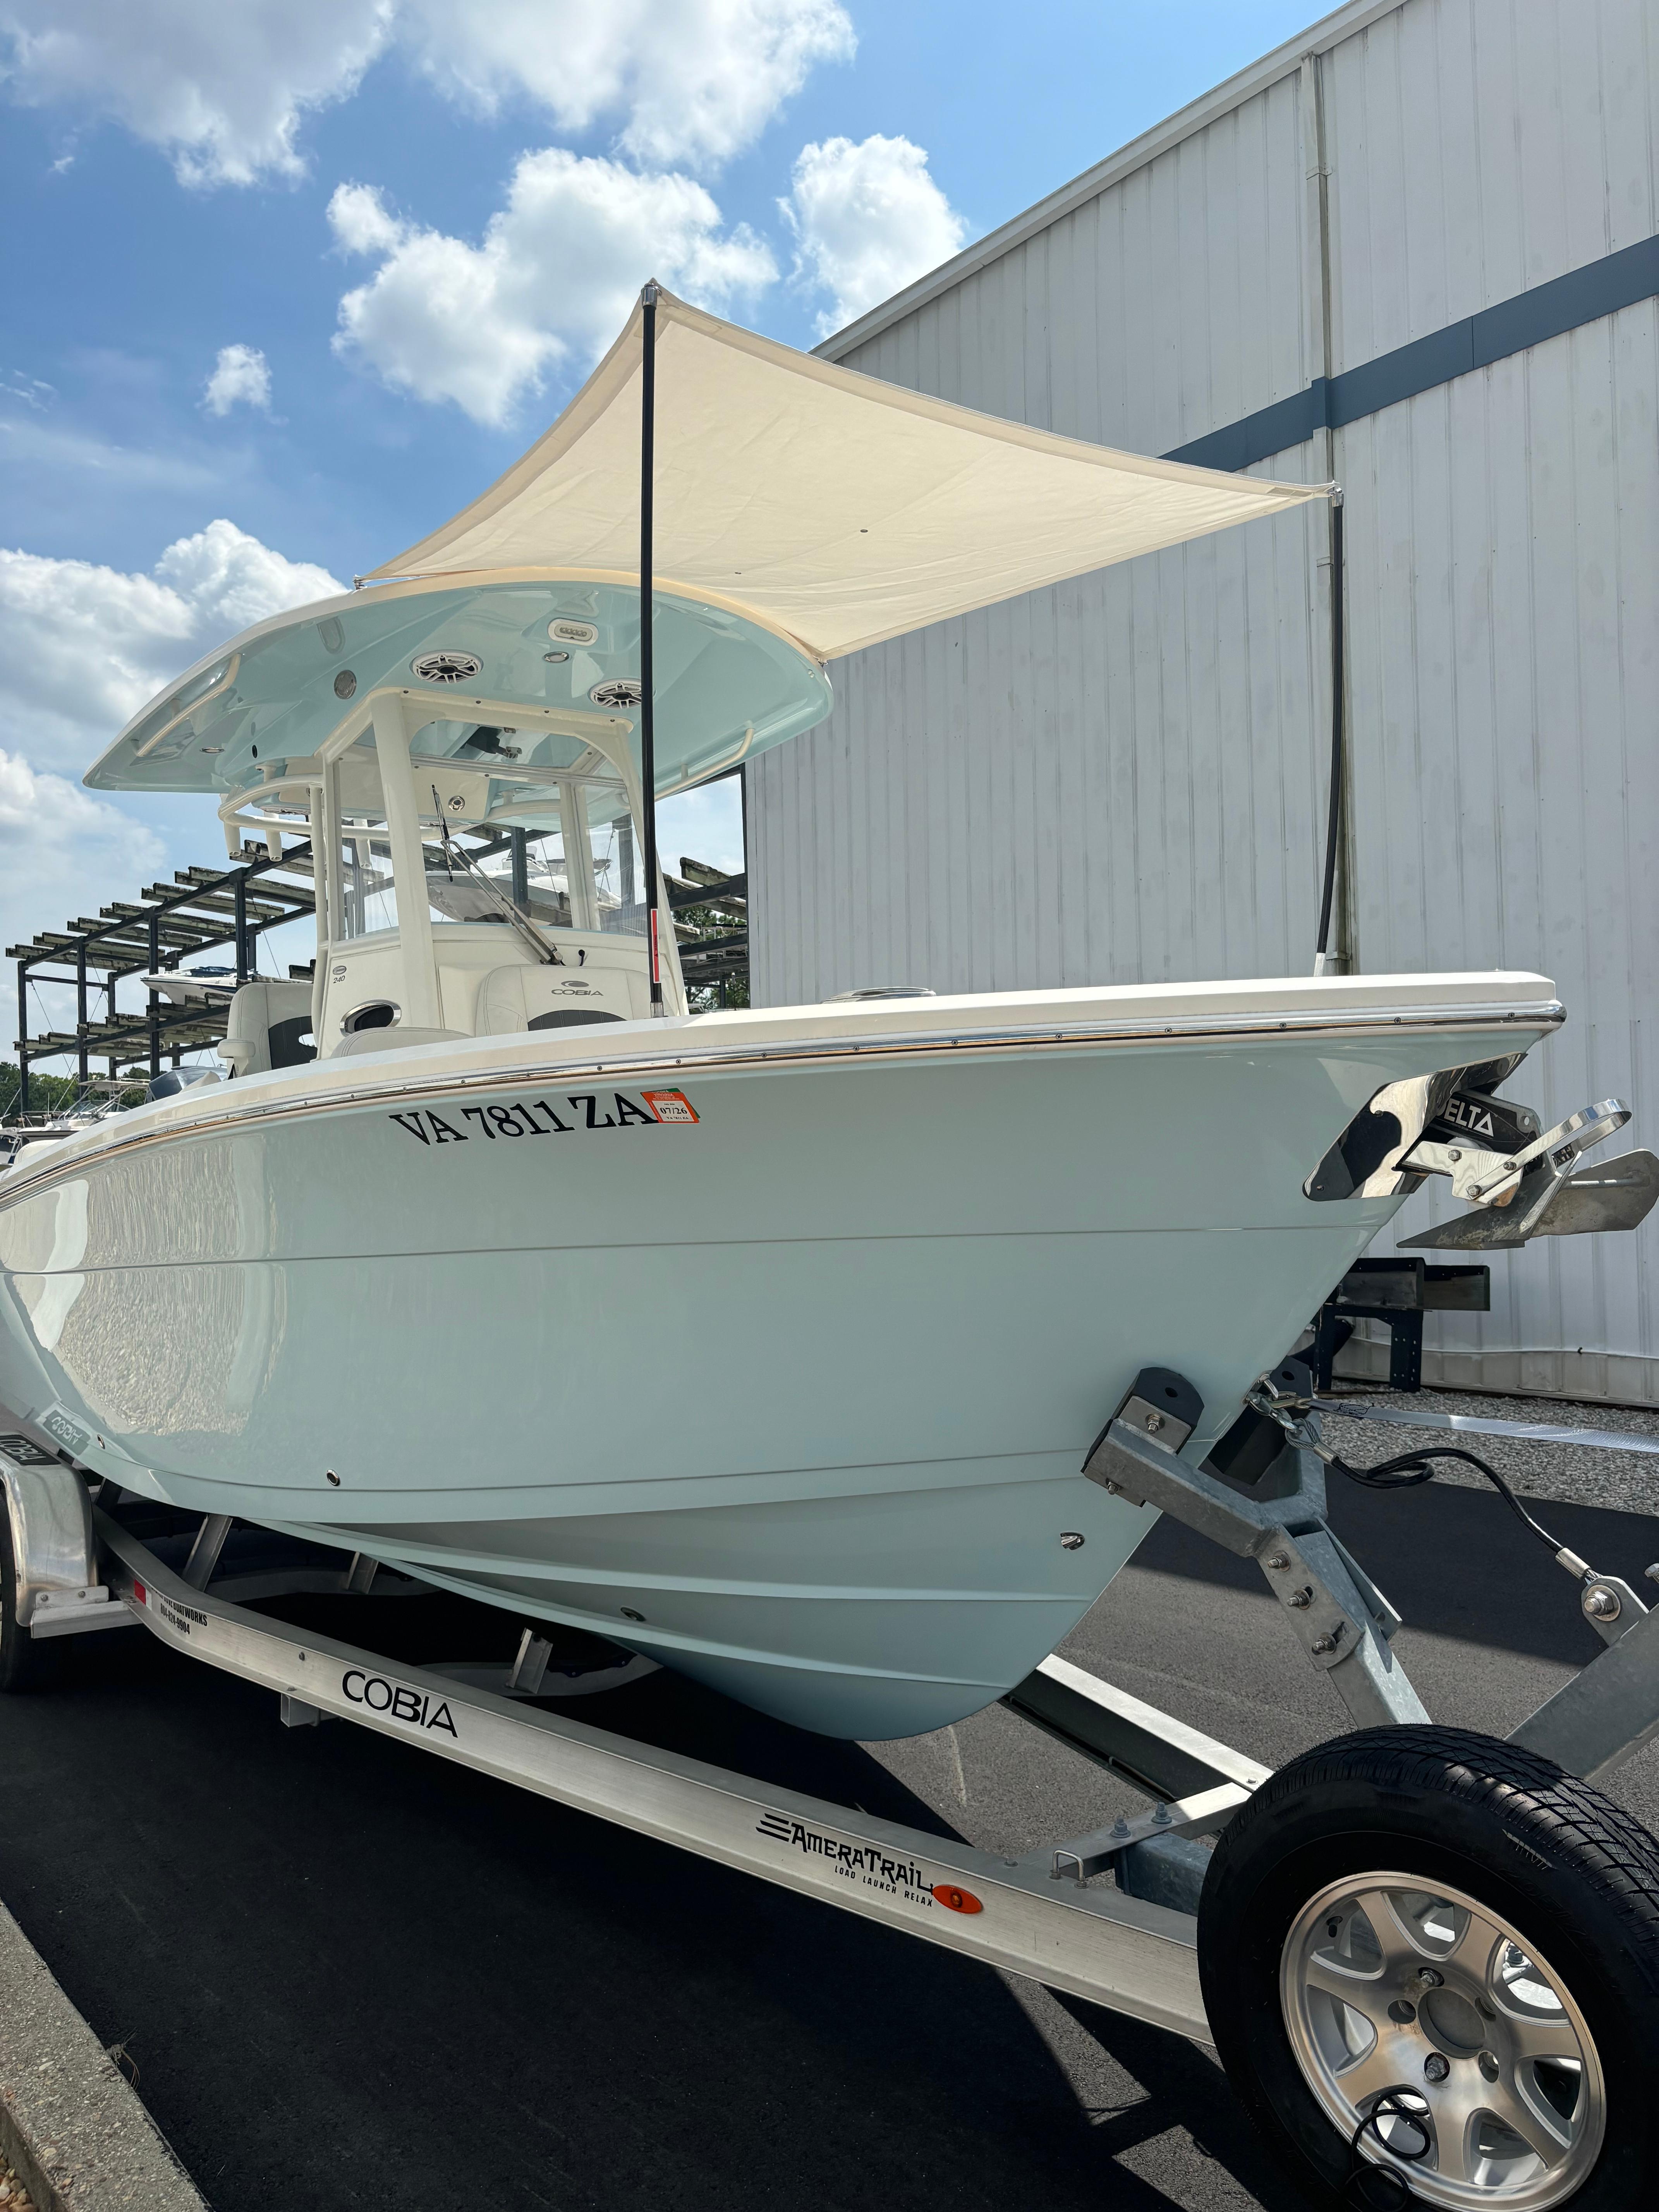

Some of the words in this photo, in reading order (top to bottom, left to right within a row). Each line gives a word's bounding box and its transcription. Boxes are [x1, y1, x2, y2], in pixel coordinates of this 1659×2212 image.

[333, 975, 345, 984] 240
[388, 1110, 469, 1145] VA
[460, 1101, 575, 1139] 7811
[567, 1093, 659, 1129] ZA
[0, 1439, 46, 1461] COBIA
[342, 1670, 458, 1738] COBIA
[835, 1865, 855, 1879] LOAD
[863, 1875, 896, 1894] LAUNCH
[904, 1890, 933, 1907] RELAX
